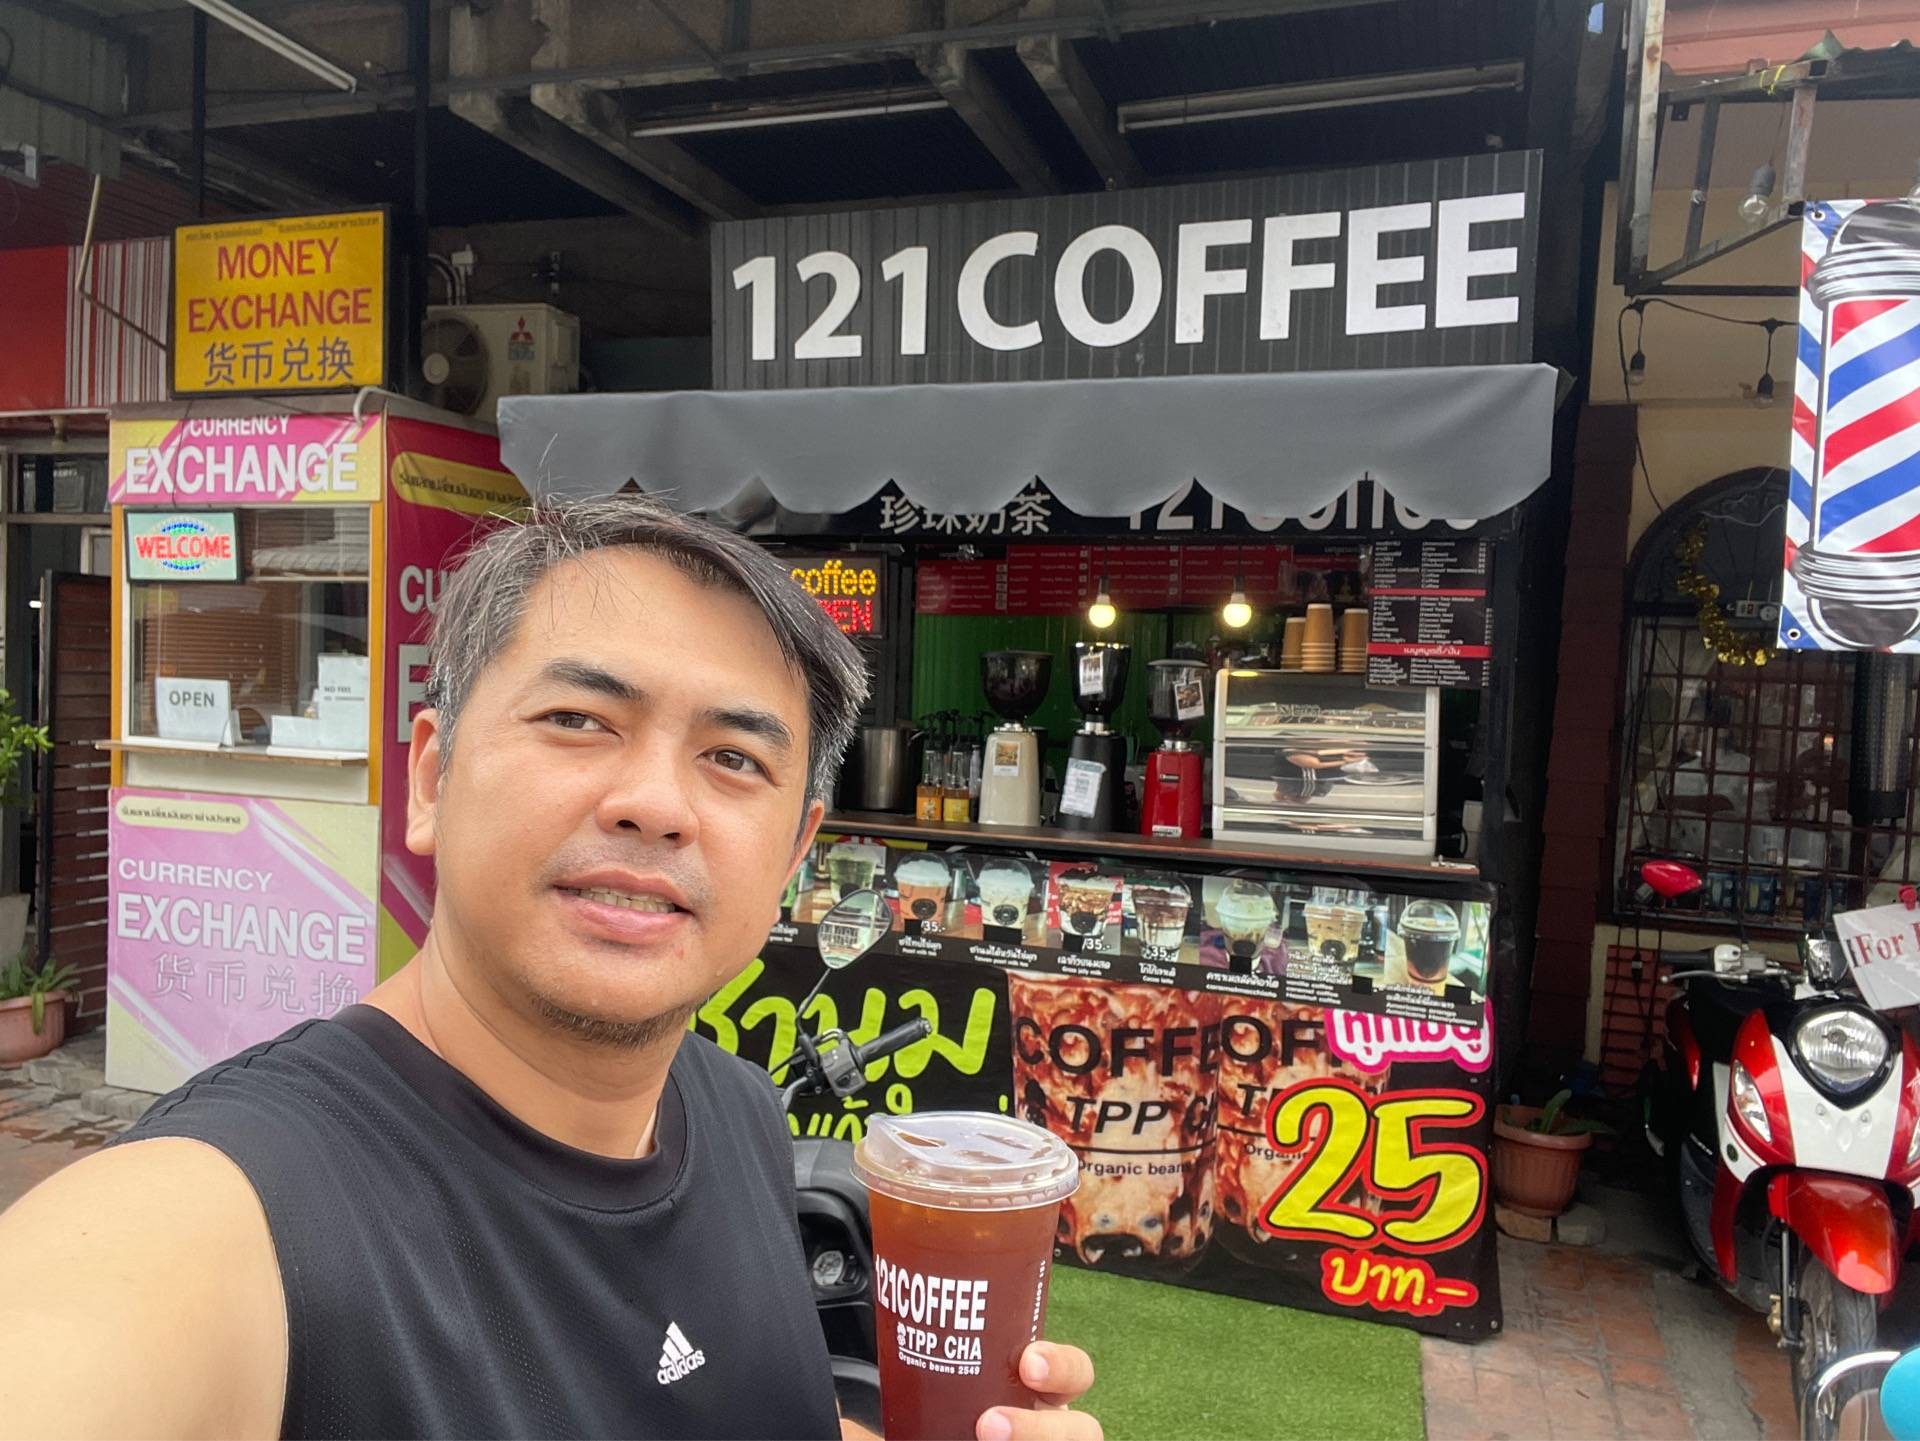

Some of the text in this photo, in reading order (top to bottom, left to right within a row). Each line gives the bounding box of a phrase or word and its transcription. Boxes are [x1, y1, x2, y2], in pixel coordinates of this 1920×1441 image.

[217, 236, 340, 281] MONEY
[187, 287, 373, 334] EXCHANGE
[203, 336, 354, 386] 货币兑换
[189, 416, 290, 437] CURRENCY
[125, 442, 359, 494] EXCHANGE
[136, 536, 232, 560] WELCOME
[791, 559, 877, 596] coffee
[168, 690, 216, 710] OPEN
[118, 858, 273, 893] CURRENCY
[116, 892, 367, 966] EXCHANGE
[1855, 933, 1904, 965] For
[1067, 1096, 1169, 1135] TPP
[1267, 1086, 1482, 1243] 25
[875, 1253, 988, 1331] 121COFFEE
[898, 1351, 927, 1369] Organic
[929, 1361, 955, 1375] beans
[944, 1335, 981, 1360] CHA
[657, 1350, 706, 1385] adidas
